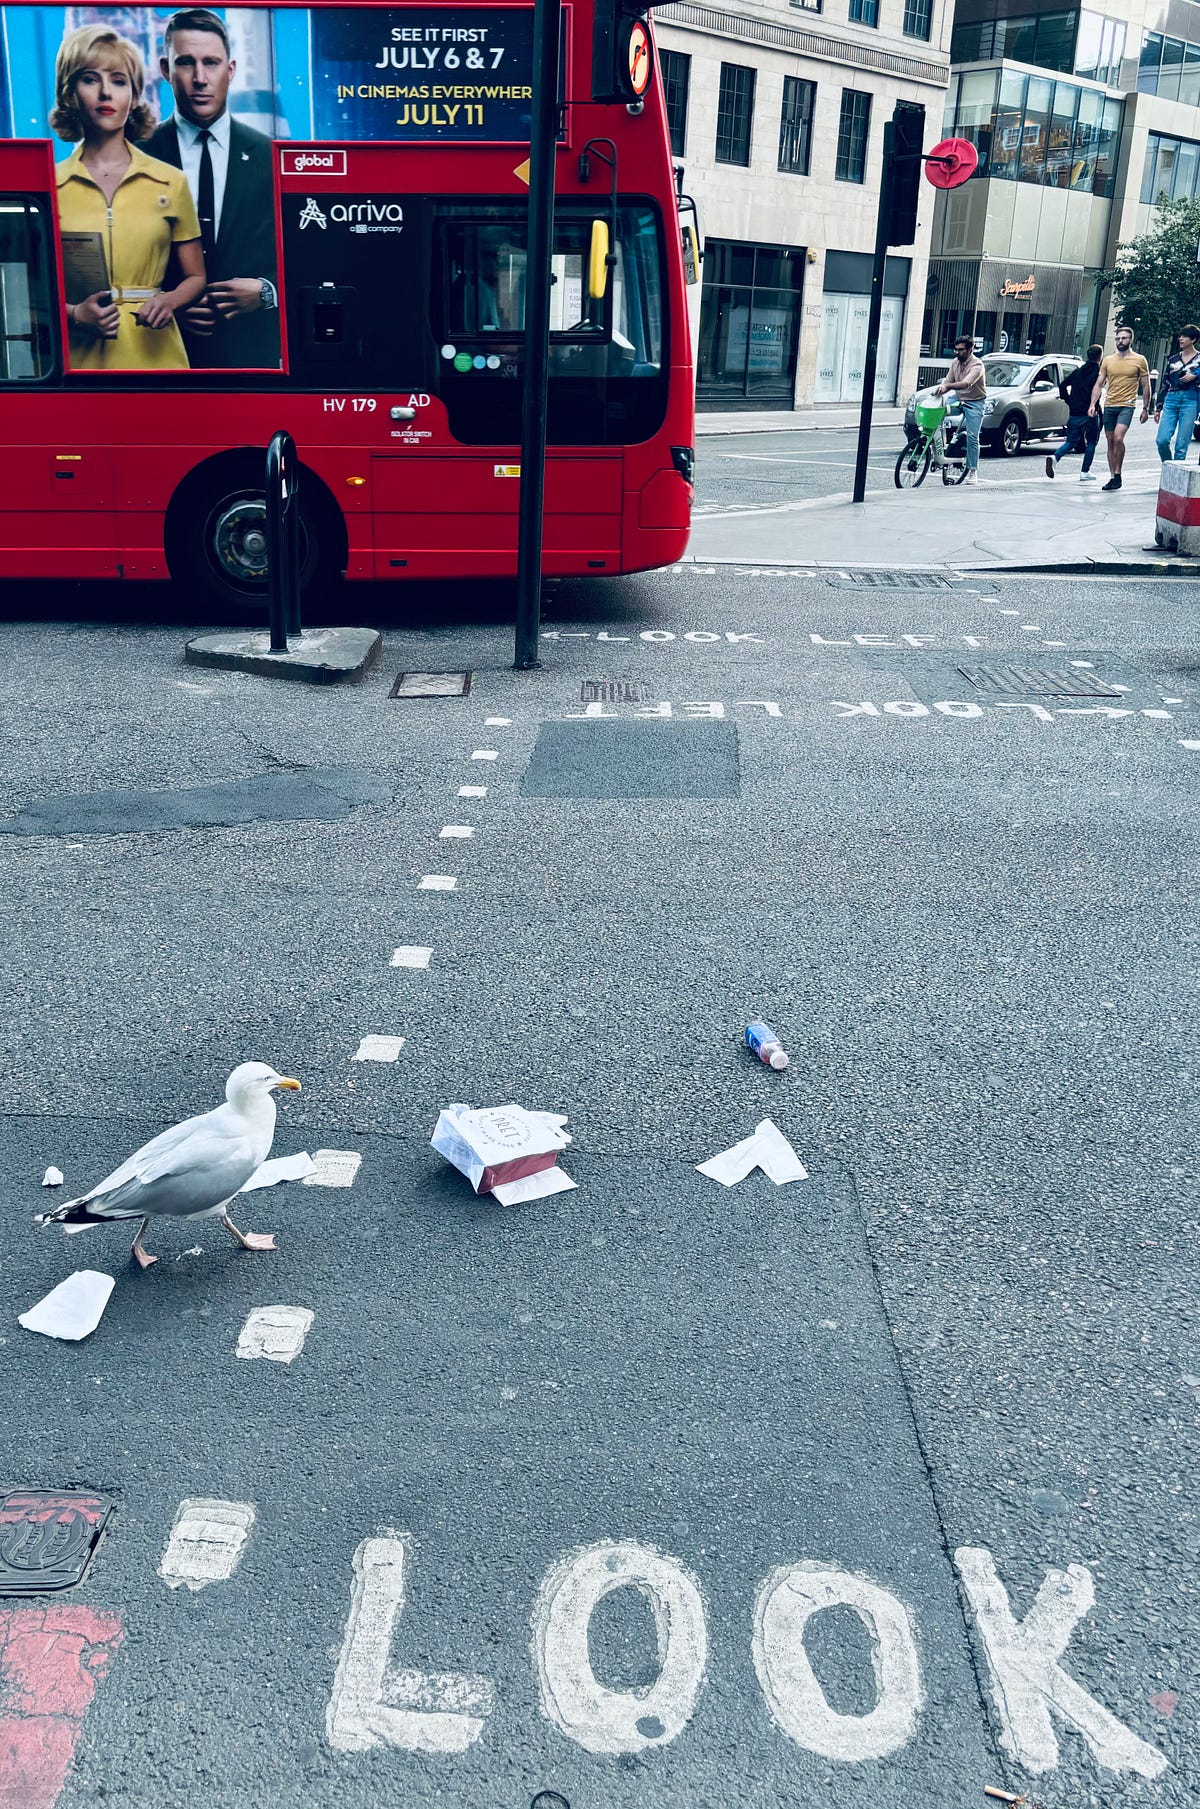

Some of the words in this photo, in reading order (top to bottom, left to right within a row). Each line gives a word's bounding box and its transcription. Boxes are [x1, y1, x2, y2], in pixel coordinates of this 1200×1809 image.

[391, 28, 422, 42] SEE
[425, 28, 440, 42] IT
[442, 28, 488, 42] FIRST
[375, 47, 440, 70] JULY
[444, 47, 461, 69] 6
[466, 47, 485, 69] &
[489, 47, 505, 69] 7
[337, 85, 355, 98] IN
[358, 85, 429, 99] CINEMAS
[432, 85, 533, 99] EVERYWHER
[396, 104, 461, 125] JULY
[464, 104, 484, 125] 11
[294, 154, 334, 171] global
[330, 200, 403, 222] arriva
[368, 226, 403, 234] company
[323, 398, 346, 412] HV
[351, 398, 377, 412] 179
[407, 394, 431, 407] AD
[596, 630, 766, 644] LOOK
[809, 633, 988, 648] LEFT
[565, 701, 784, 719] LEFT
[830, 701, 1055, 722] LOOK
[490, 1117, 520, 1138] PRET
[325, 1526, 1170, 1781] LOOK
